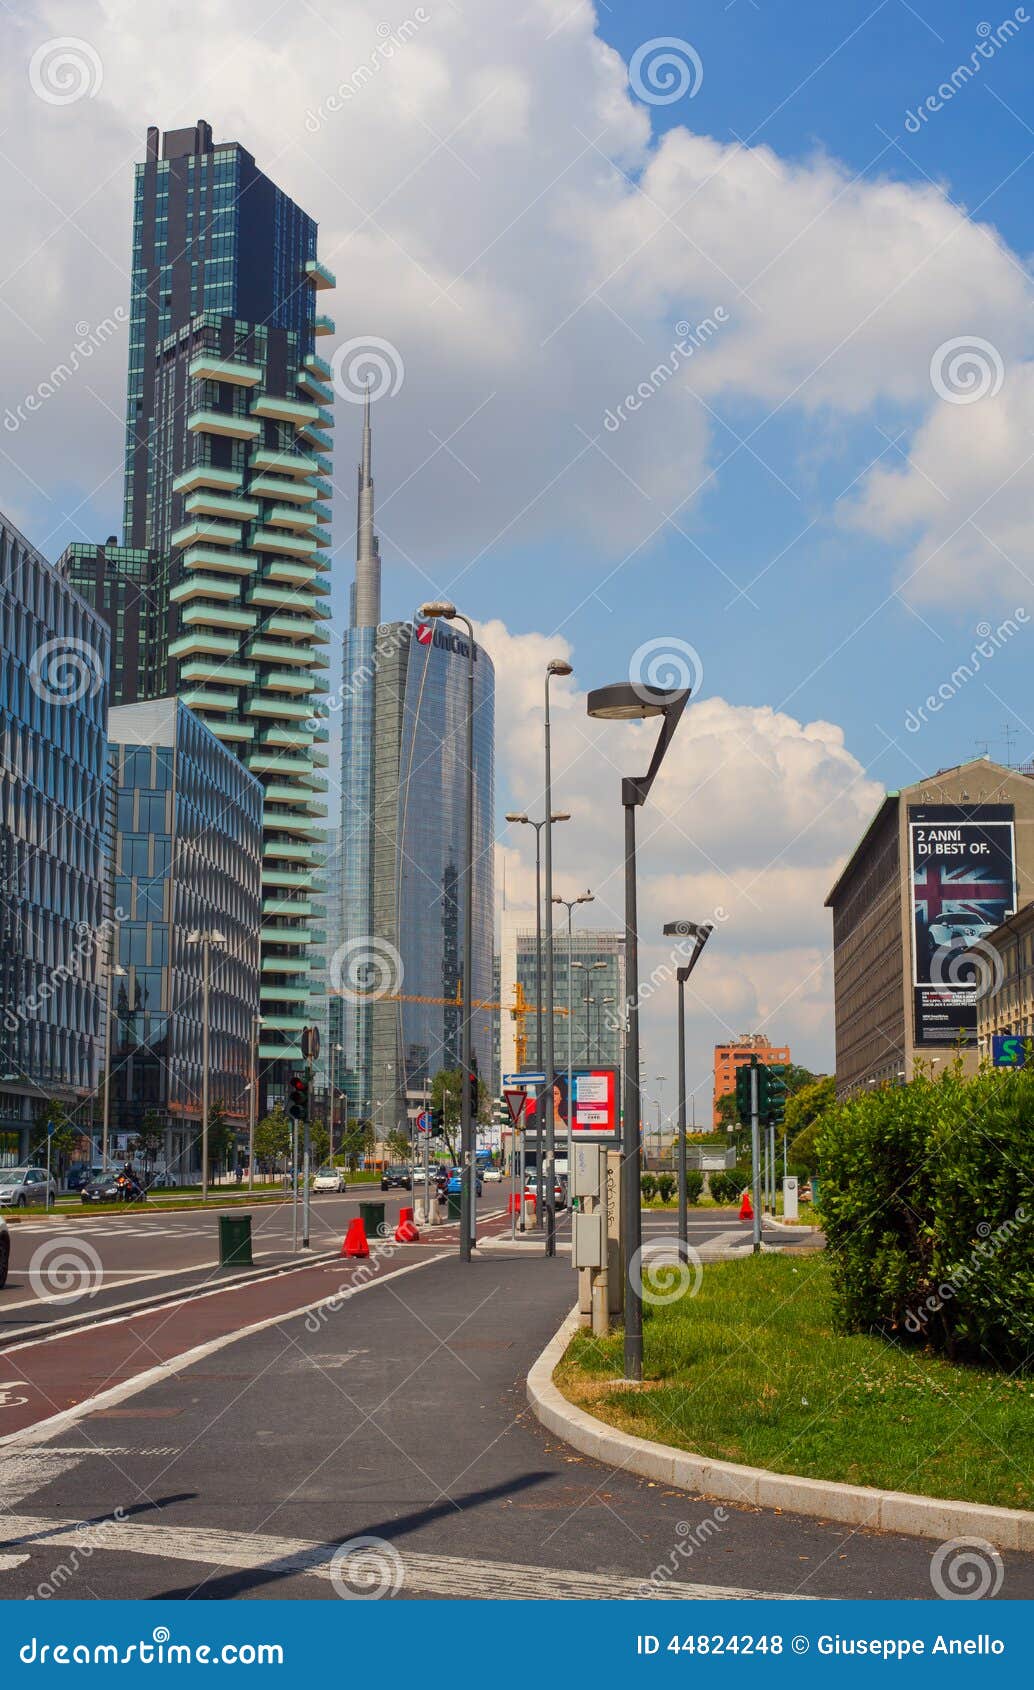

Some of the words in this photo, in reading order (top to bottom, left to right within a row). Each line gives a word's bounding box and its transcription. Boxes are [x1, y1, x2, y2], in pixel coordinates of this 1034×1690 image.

[917, 830, 925, 841] 2
[928, 830, 961, 841] ANNI
[918, 843, 931, 854] DI
[935, 843, 966, 854] BEST
[969, 843, 990, 854] OF.
